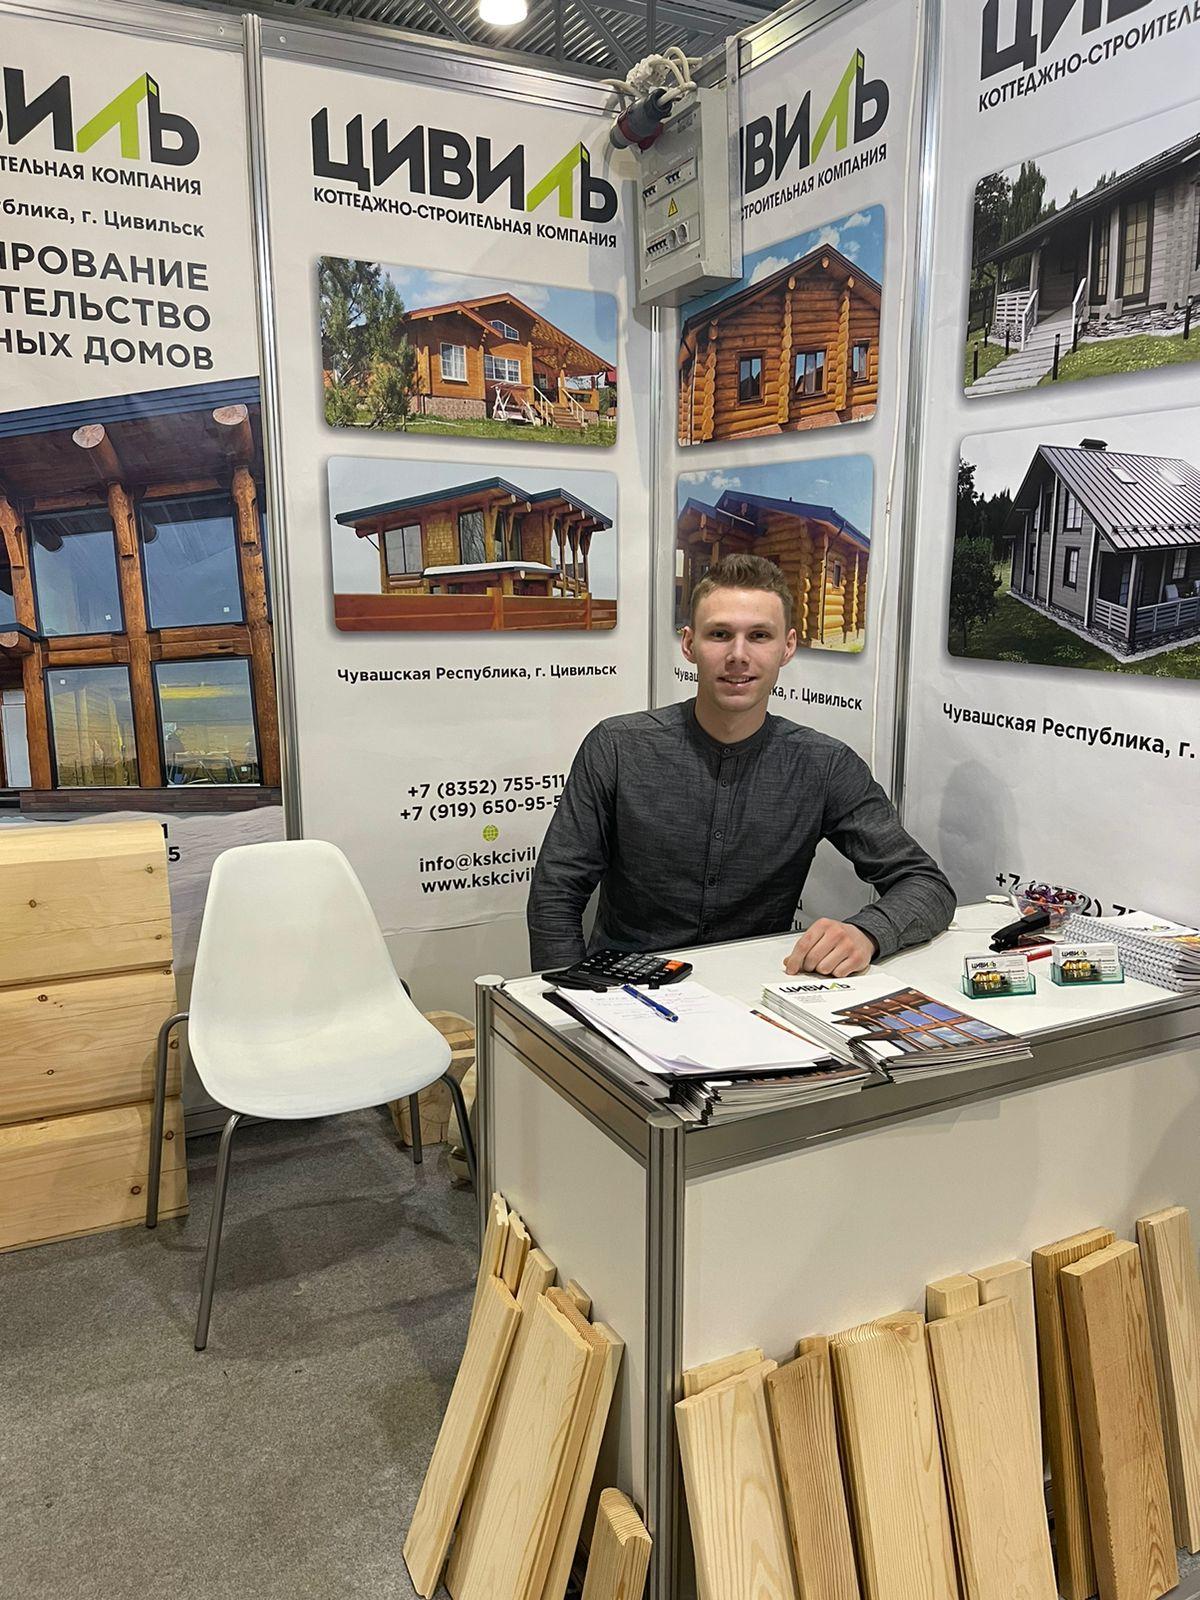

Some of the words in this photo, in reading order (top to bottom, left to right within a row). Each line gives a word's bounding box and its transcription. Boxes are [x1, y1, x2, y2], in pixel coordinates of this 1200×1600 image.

[0, 67, 200, 166] ИЛЬ
[740, 48, 890, 195] ВИЛЬ
[92, 166, 202, 195] КОМПАНИЯ
[311, 107, 618, 223] ЦИВИЛЬ
[817, 143, 887, 188] КОМПАНИЯ
[0, 198, 75, 225] блика,
[82, 210, 97, 224] г.
[104, 210, 205, 237] Цивильск
[313, 187, 531, 236] КОТТЕДЖНО-СТРОИТЕЛЬНАЯ
[537, 223, 617, 248] КОМПАНИЯ
[84, 335, 214, 370] ДОМОВ
[338, 668, 430, 685] Чувашская
[436, 665, 531, 681] Республика,
[535, 667, 546, 677] г.
[550, 664, 617, 679] Цивильск
[790, 688, 798, 700] г.
[801, 688, 862, 711] Цивильск
[943, 703, 1035, 732] Чувашская
[1042, 718, 1170, 758] Республика,
[1179, 742, 1195, 758] г.
[408, 784, 430, 798] +7
[437, 780, 497, 799] (8352)
[503, 774, 565, 792] 755-511
[400, 806, 423, 821] +7
[430, 802, 476, 821] (919)
[419, 846, 536, 873] info@kskcivil
